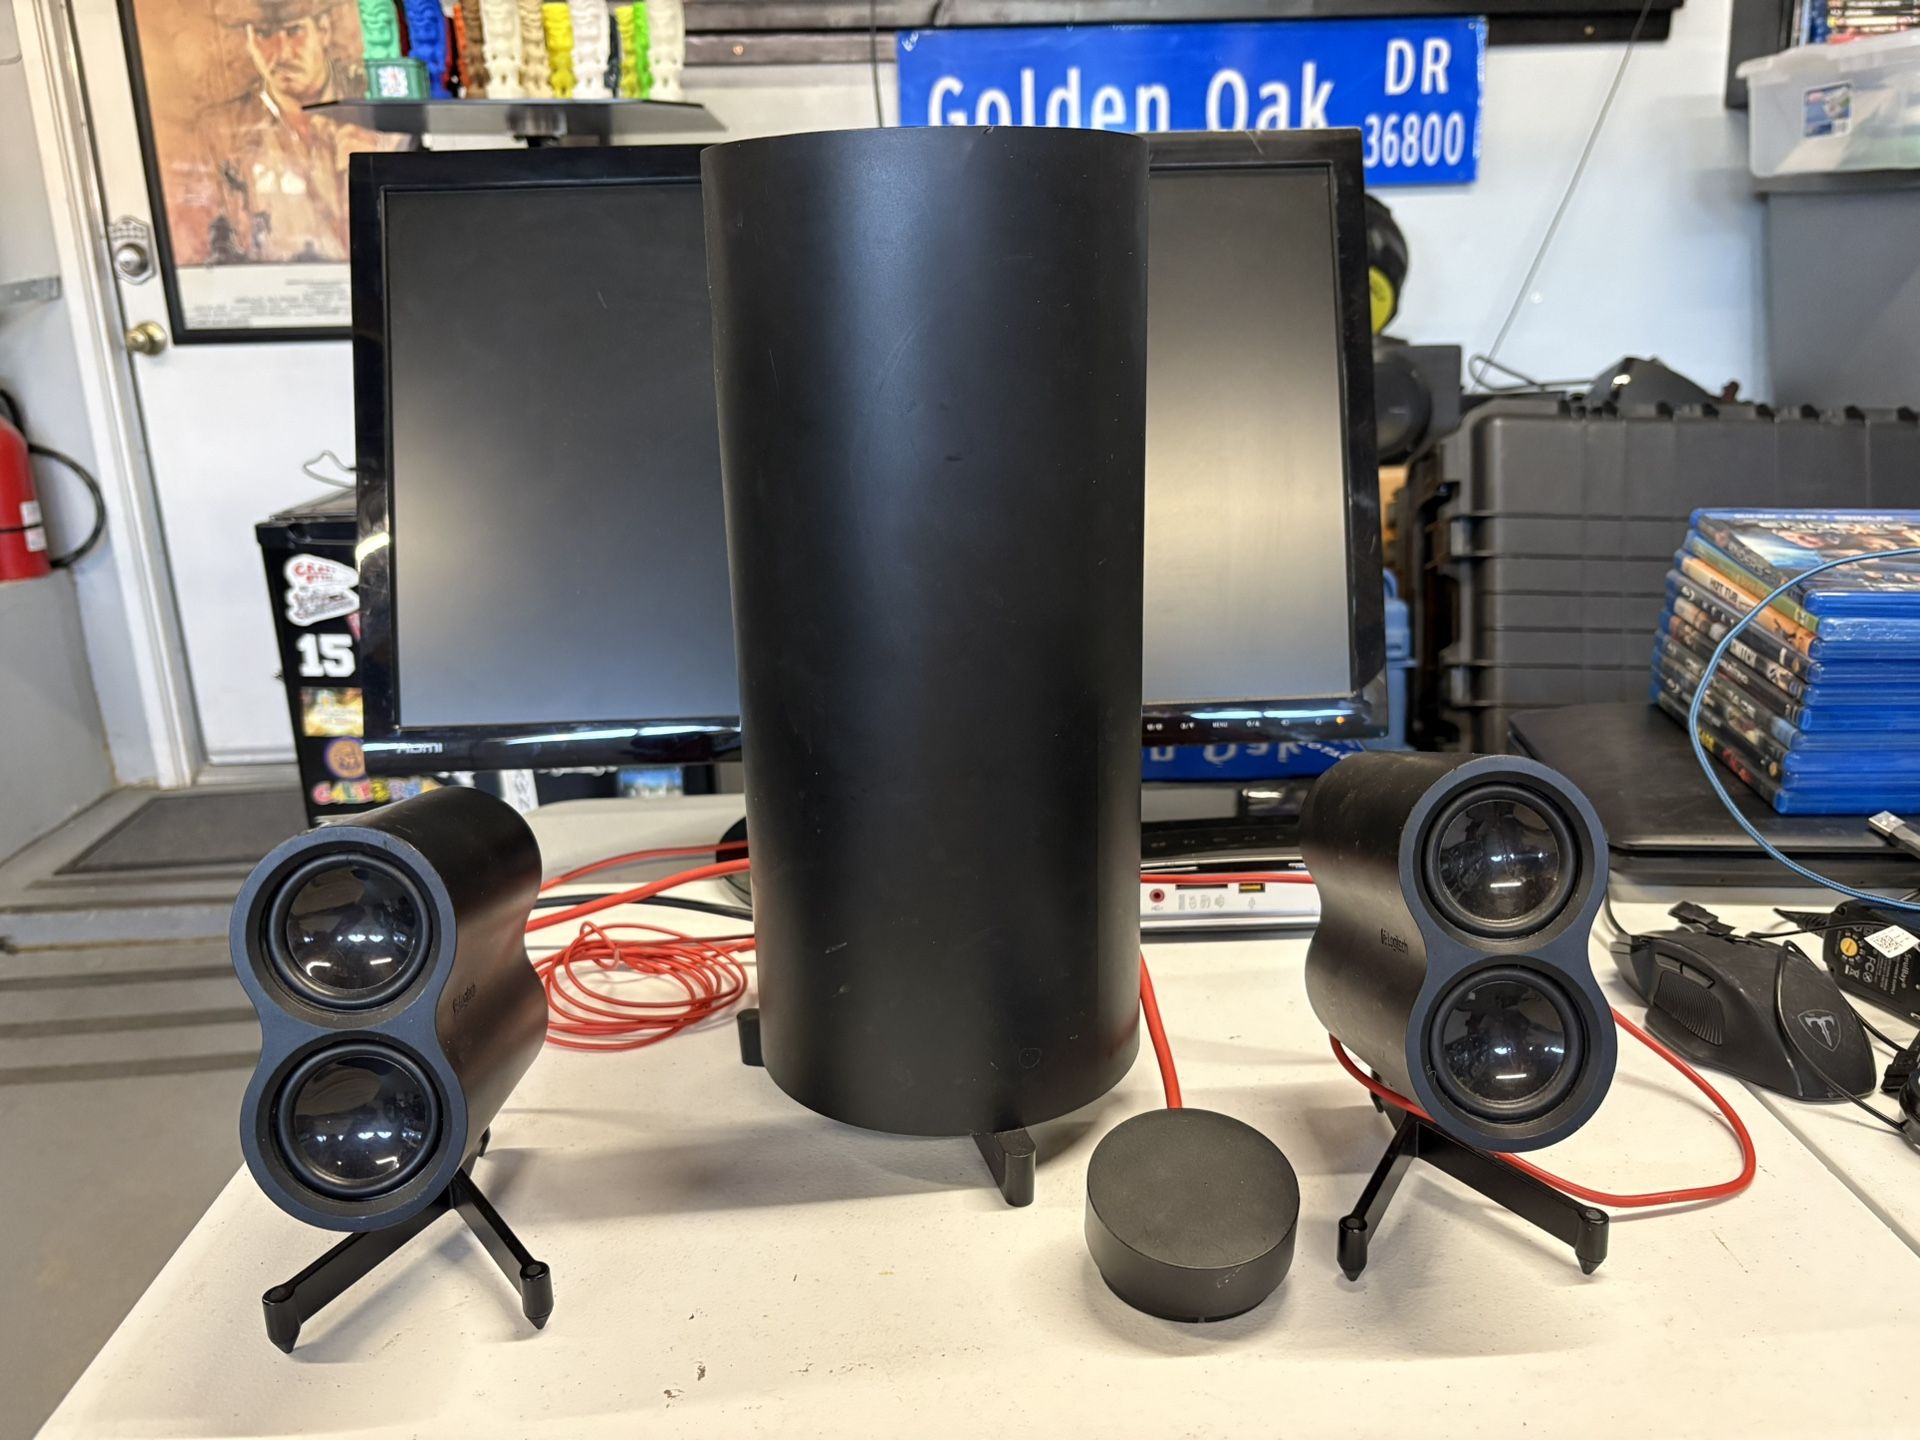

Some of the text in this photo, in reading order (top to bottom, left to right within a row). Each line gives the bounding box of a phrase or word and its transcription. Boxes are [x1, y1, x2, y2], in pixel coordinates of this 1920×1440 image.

[1384, 38, 1451, 95] DR
[928, 61, 1334, 132] Golden Oak
[1364, 112, 1465, 168] 36800
[297, 633, 356, 677] 15
